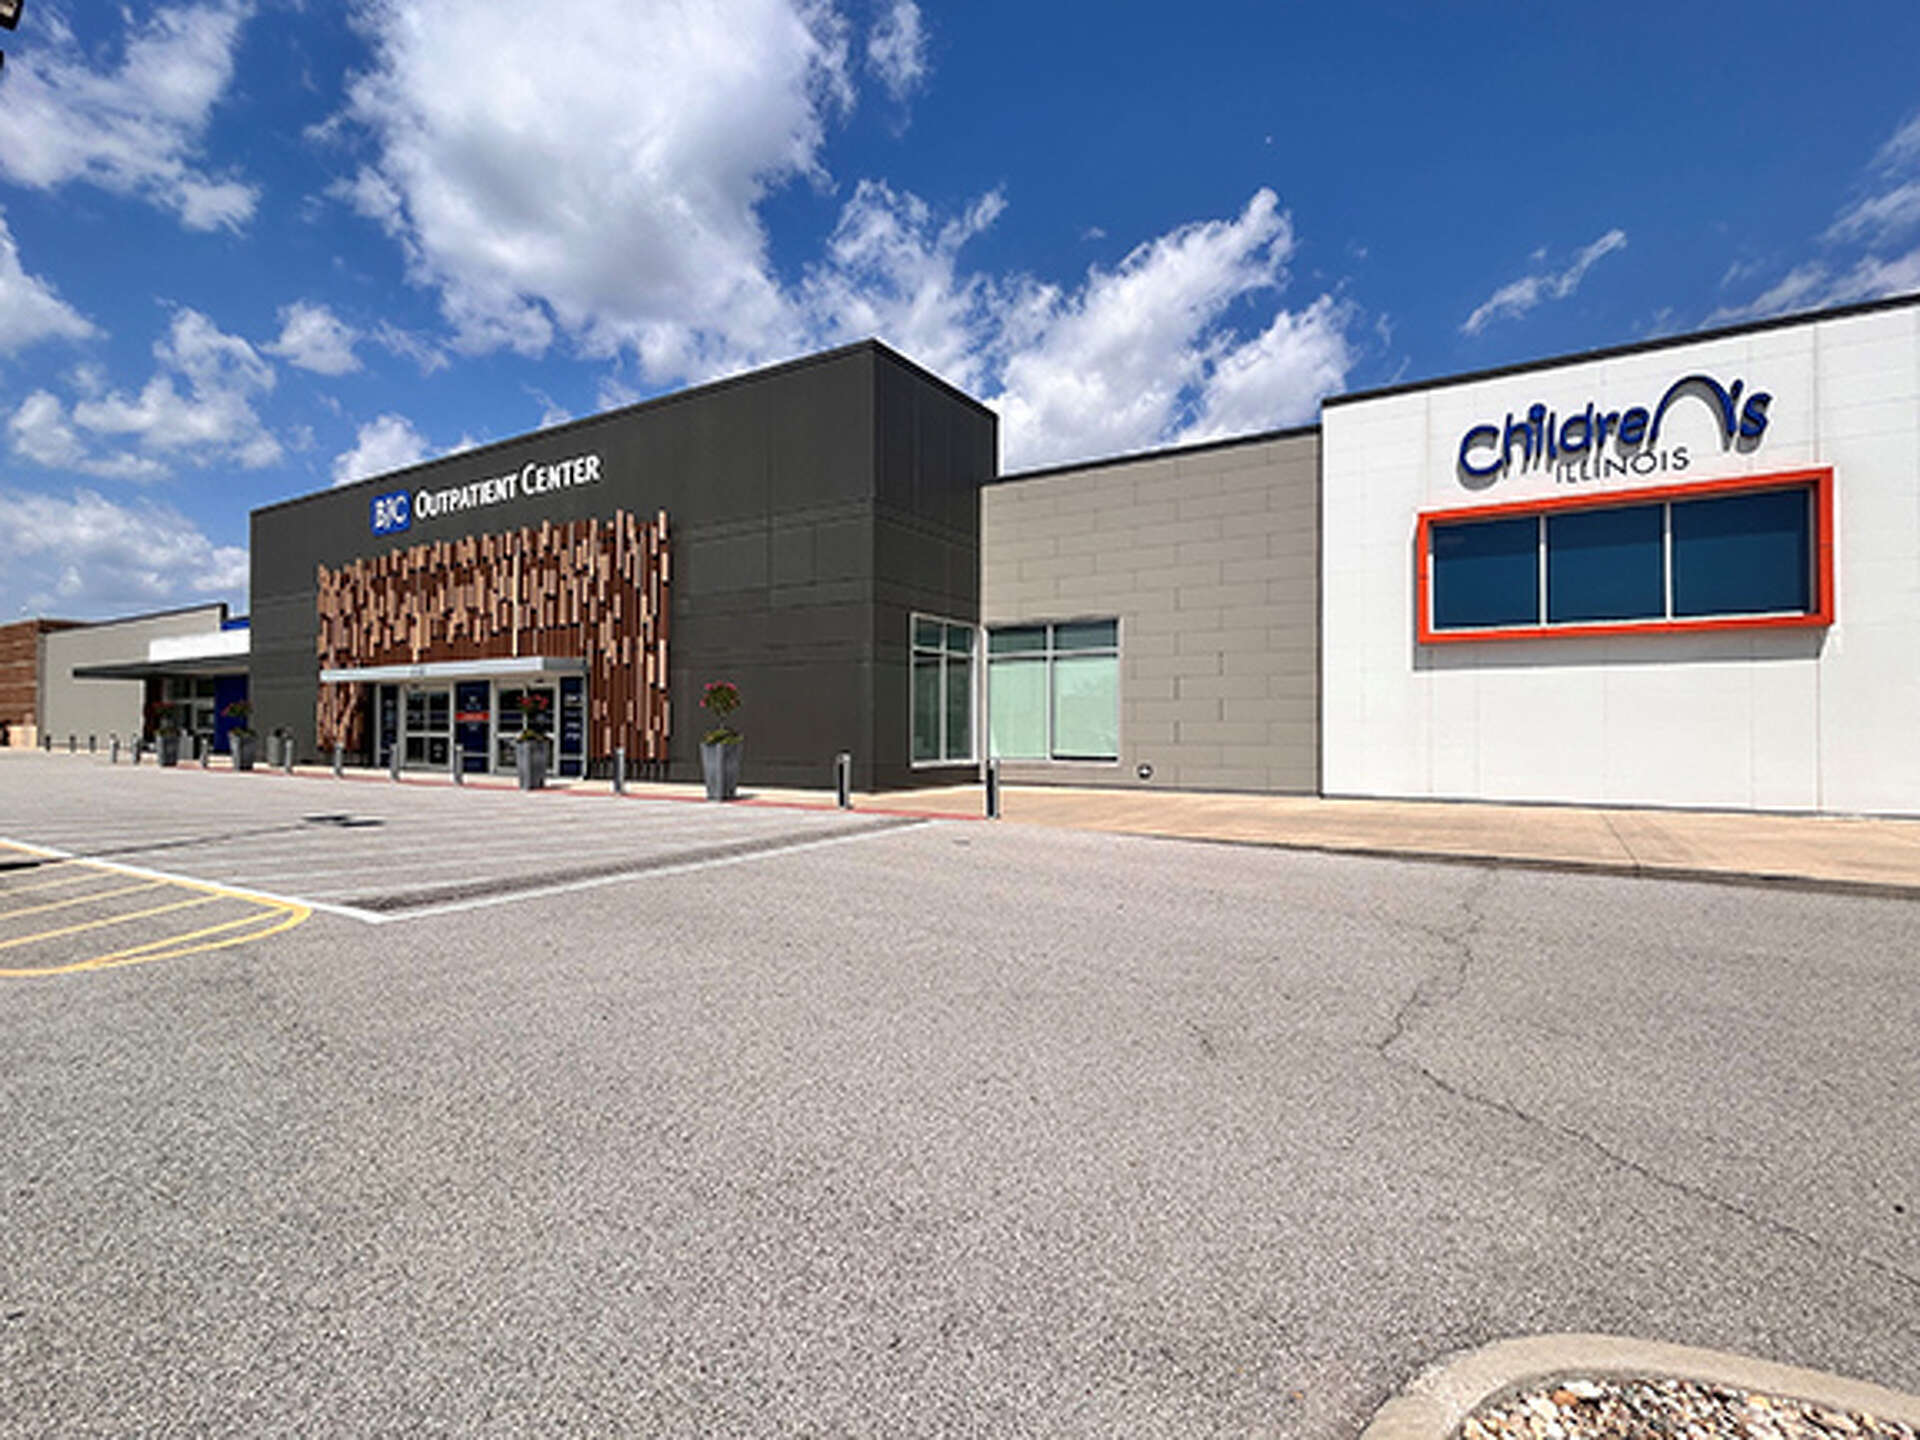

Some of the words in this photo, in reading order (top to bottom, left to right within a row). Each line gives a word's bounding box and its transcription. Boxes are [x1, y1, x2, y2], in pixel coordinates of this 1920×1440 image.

[374, 494, 409, 531] BJC
[414, 471, 519, 520] OUTPATIENT
[521, 455, 602, 496] CENTER
[1557, 447, 1690, 484] ILLINOIS
